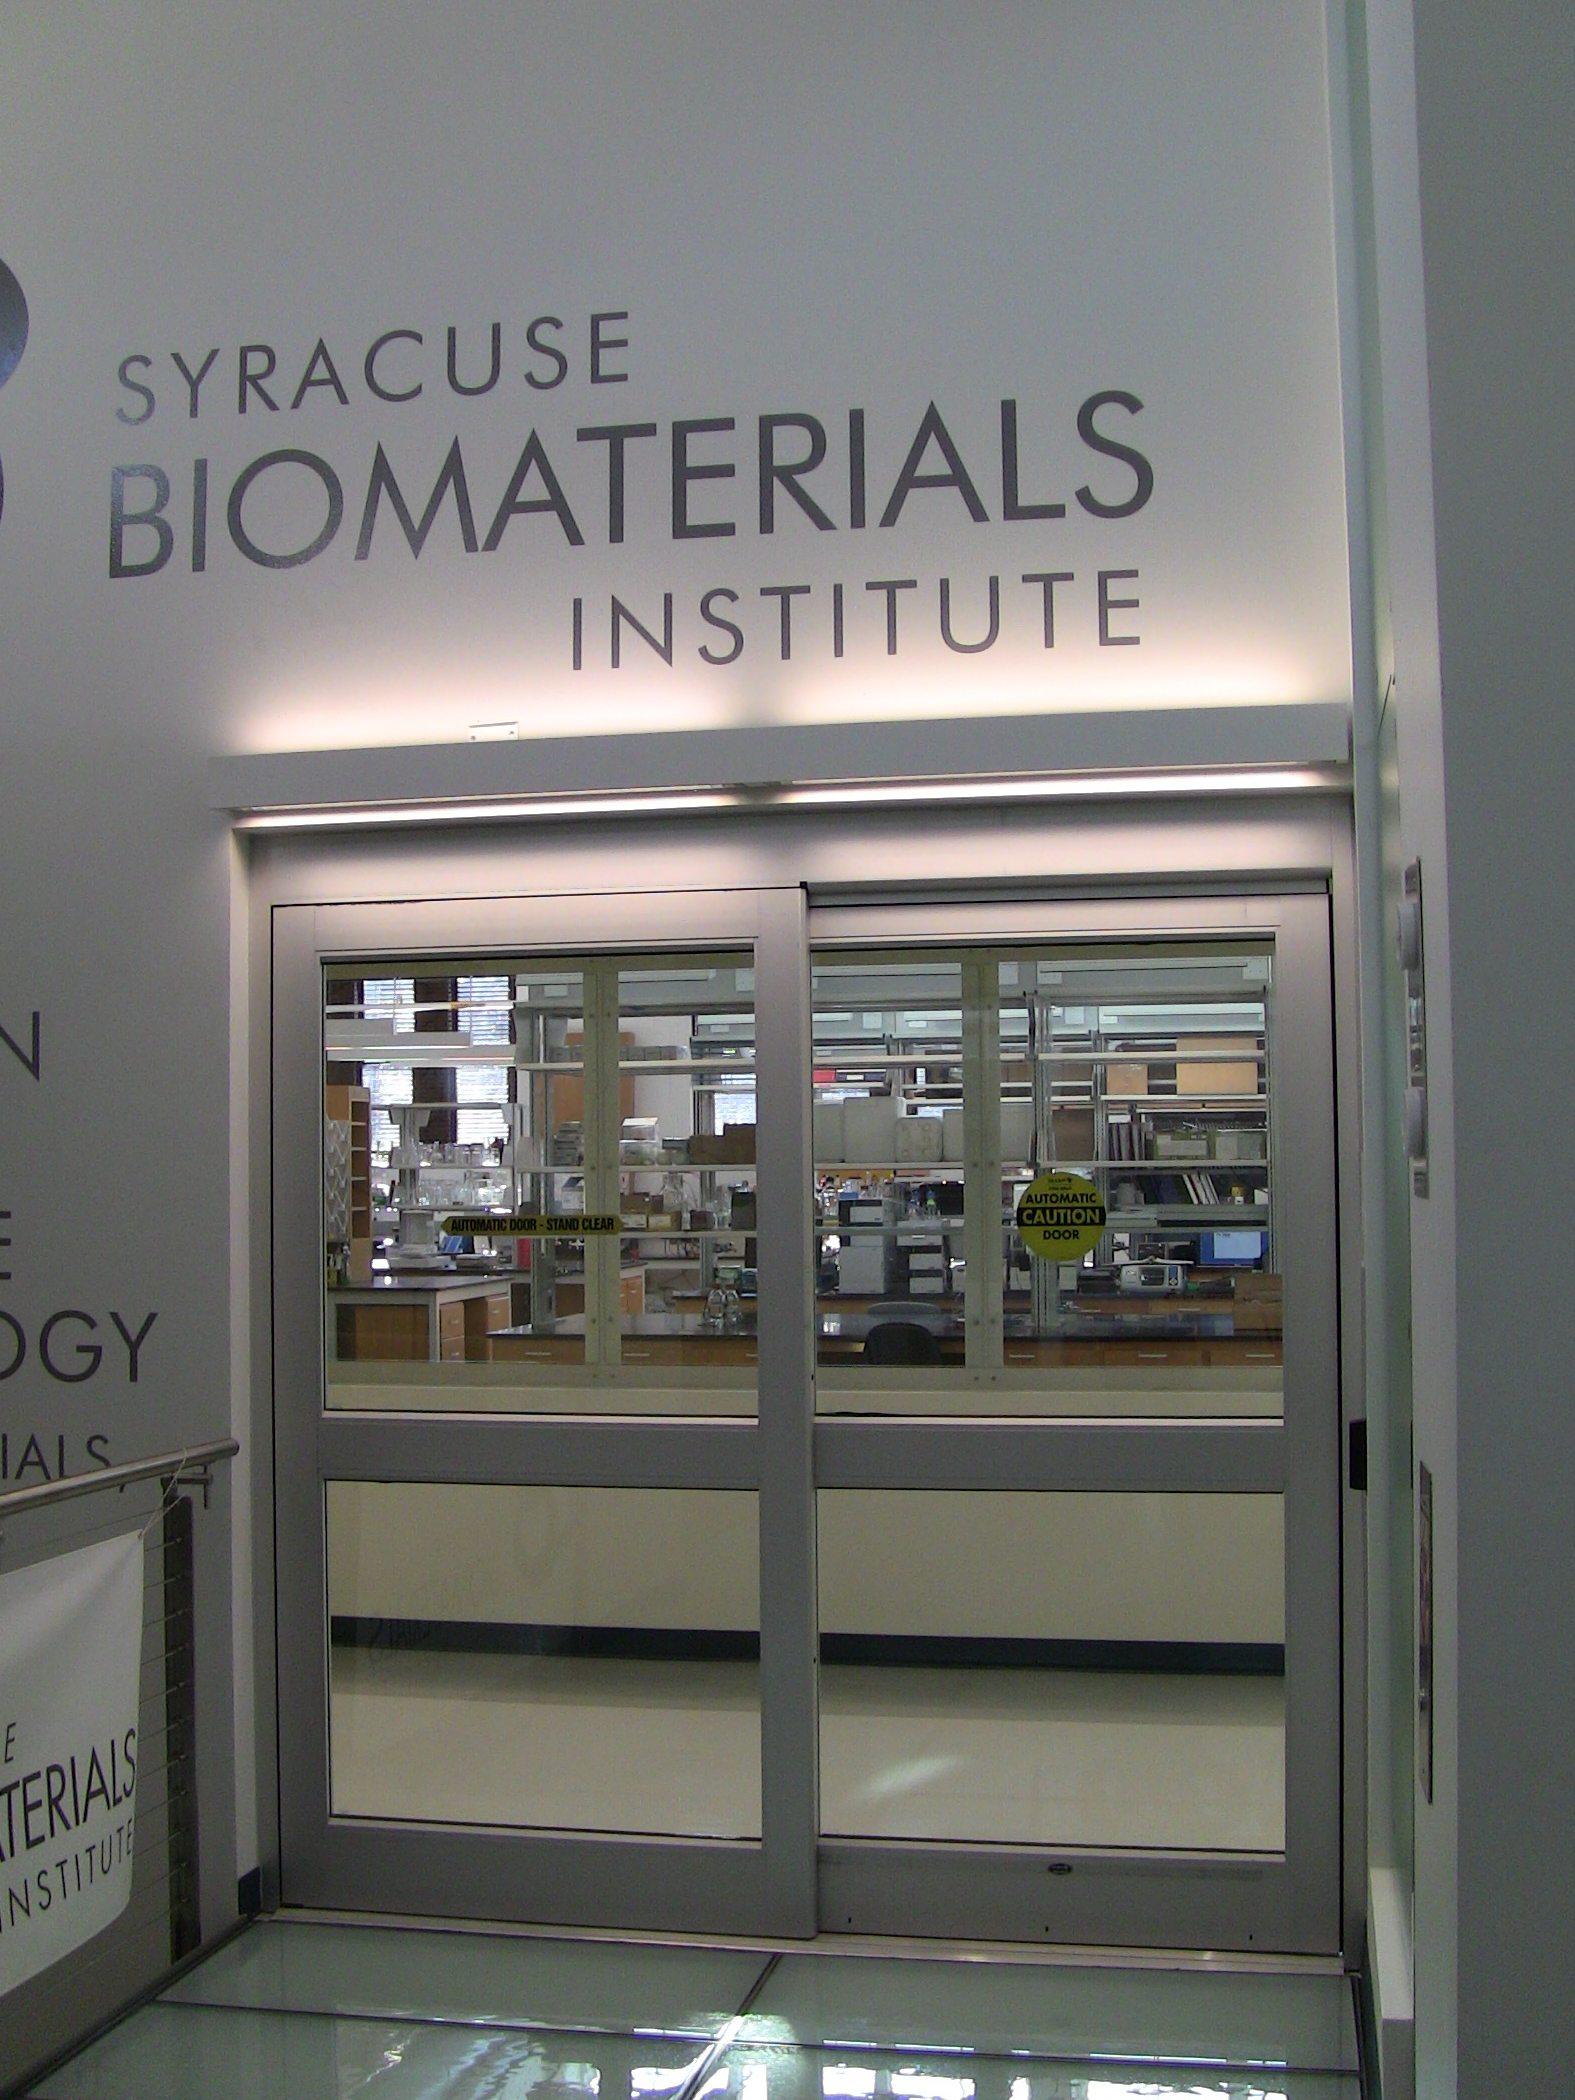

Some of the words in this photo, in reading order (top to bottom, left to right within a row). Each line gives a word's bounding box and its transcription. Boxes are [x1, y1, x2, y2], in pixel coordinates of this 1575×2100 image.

[115, 311, 629, 425] SYRACUSE
[109, 390, 1154, 578] BIOMATERIALS
[572, 569, 1141, 670] INSTITUTE
[451, 1218, 507, 1232] AUTOMATIC
[509, 1218, 537, 1232] DOOR
[546, 1217, 579, 1231] STAND
[582, 1217, 614, 1231] CLEAR
[1021, 1208, 1100, 1224] CAUTION
[1026, 1193, 1097, 1204] AUTOMATIC
[1043, 1229, 1080, 1240] DOOR
[0, 1728, 136, 1863] TERIALS
